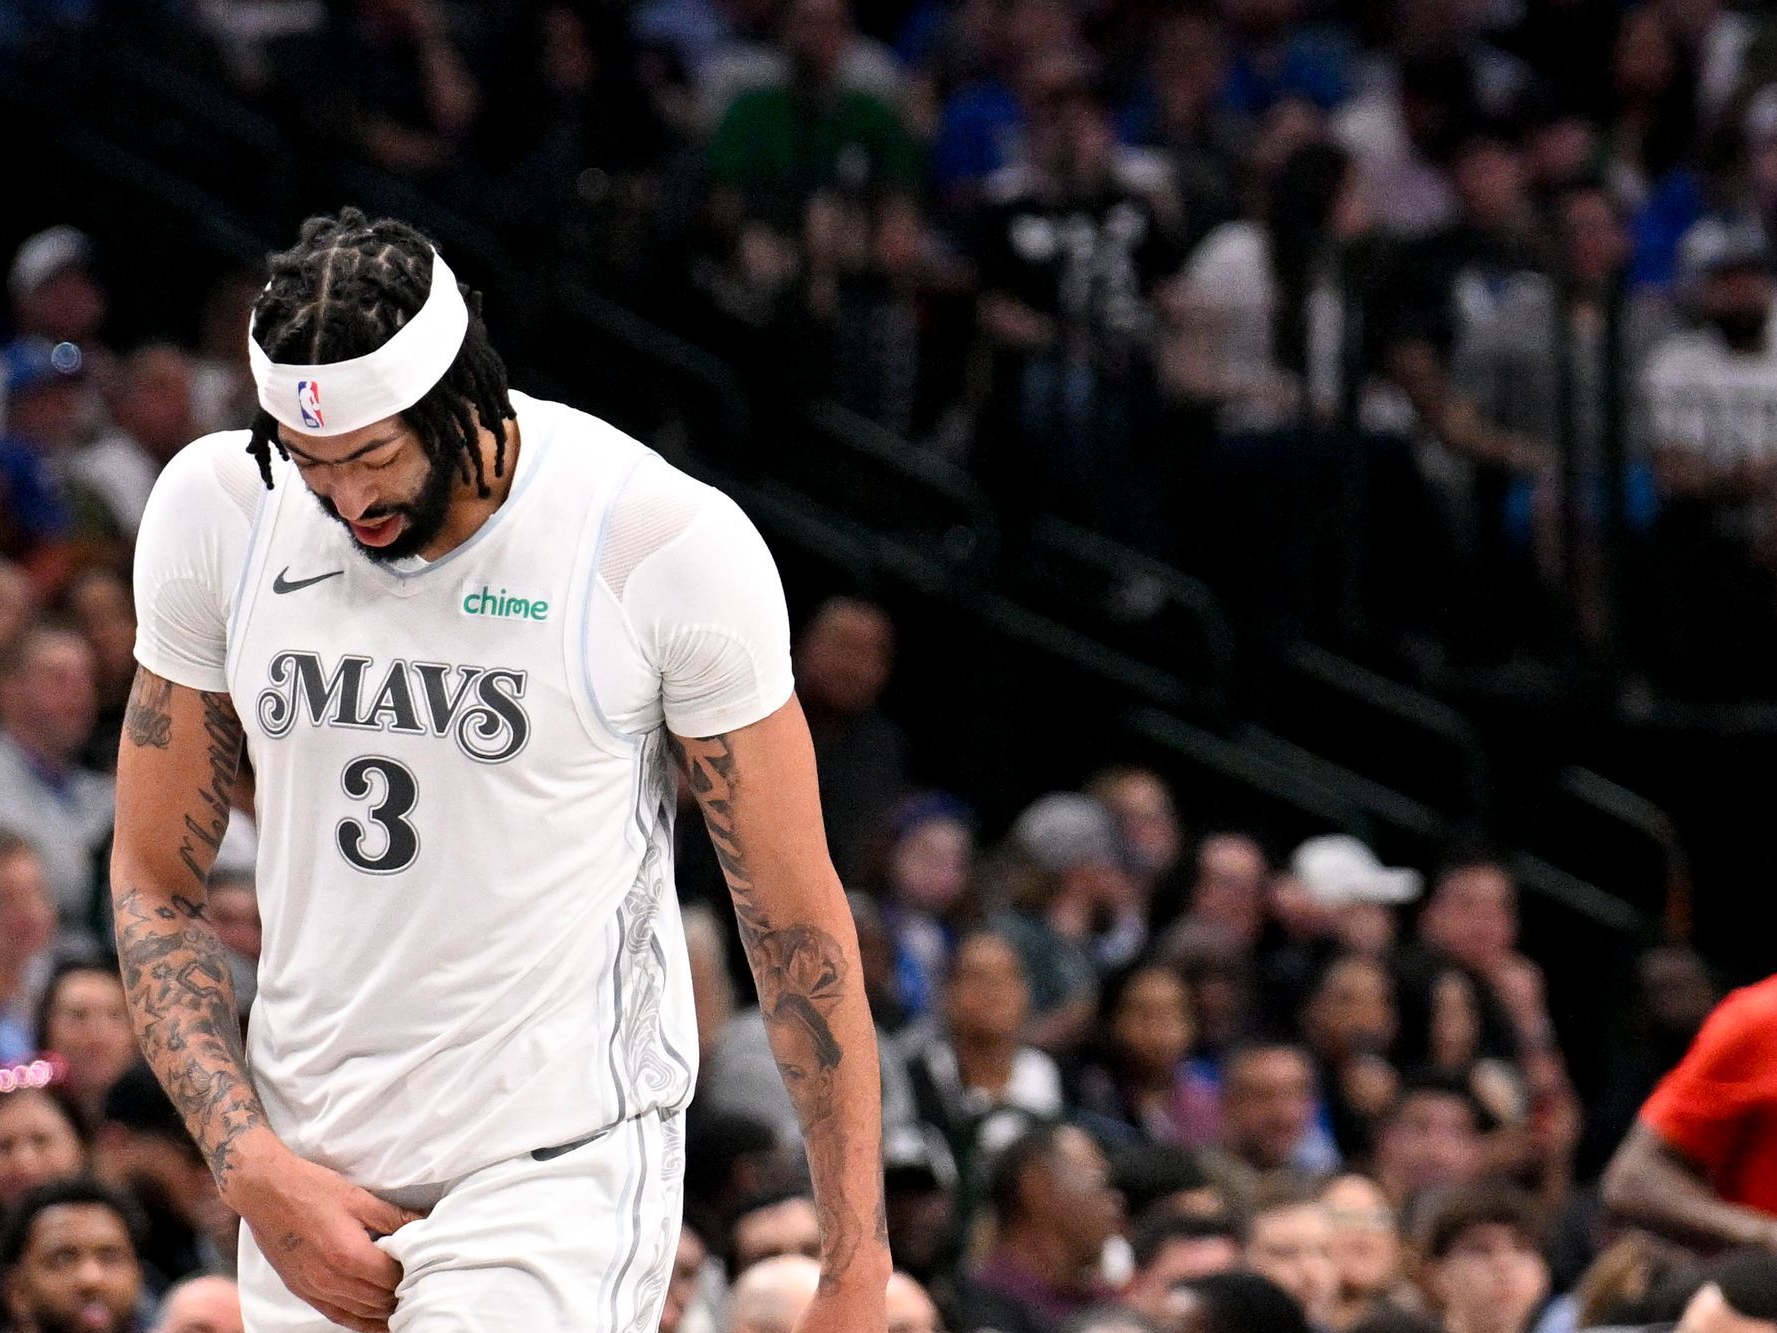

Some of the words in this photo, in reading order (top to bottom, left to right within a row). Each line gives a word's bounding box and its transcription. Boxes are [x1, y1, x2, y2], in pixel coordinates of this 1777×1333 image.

[463, 586, 549, 620] chime
[256, 649, 531, 764] MAVS
[335, 754, 421, 876] 3
